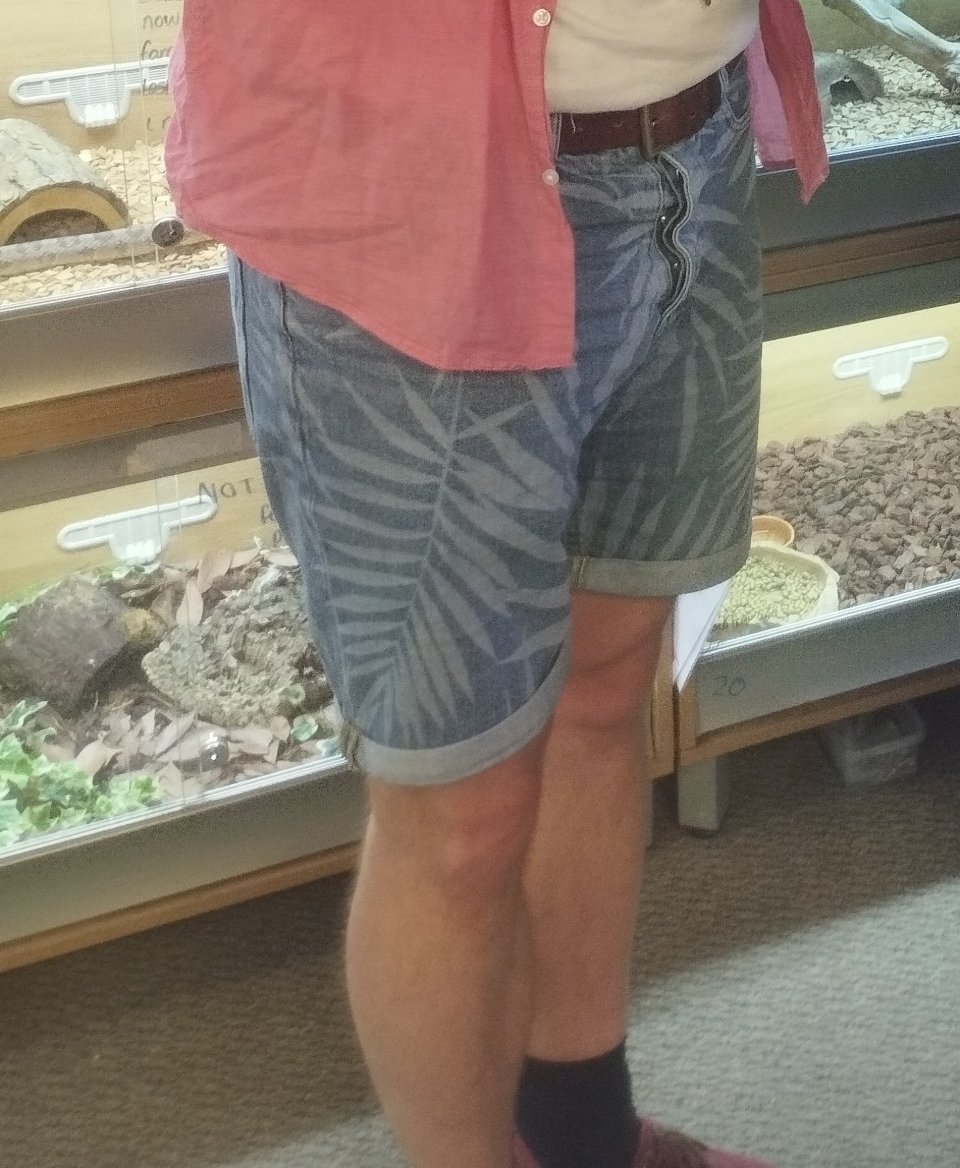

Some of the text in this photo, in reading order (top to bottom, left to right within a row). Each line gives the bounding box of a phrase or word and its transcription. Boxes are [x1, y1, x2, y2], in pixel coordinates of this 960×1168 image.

[143, 12, 180, 30] now
[199, 477, 255, 504] NOT
[712, 675, 745, 696] 20
